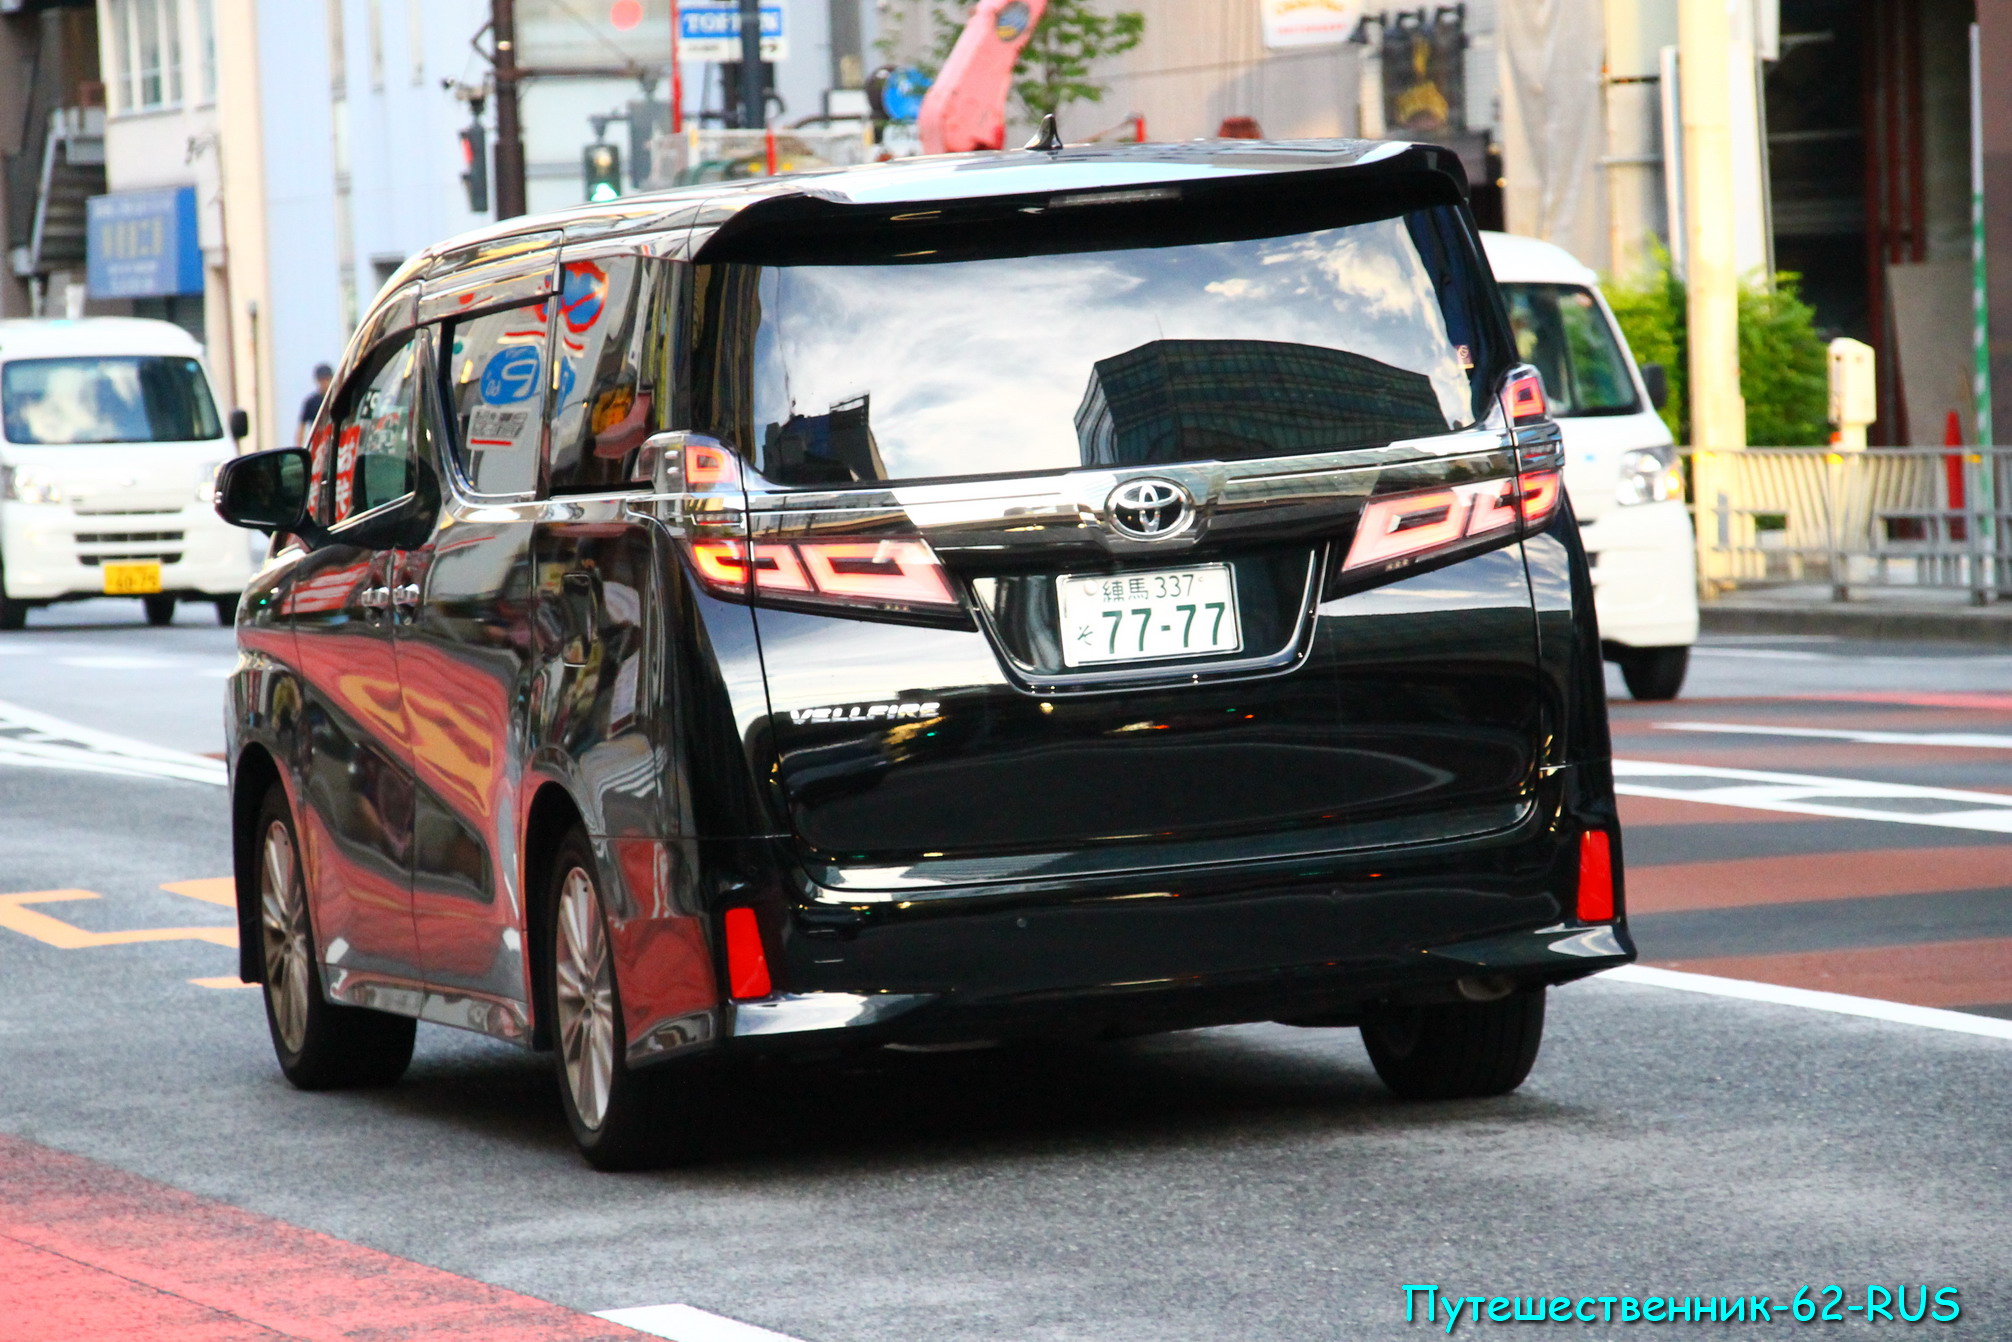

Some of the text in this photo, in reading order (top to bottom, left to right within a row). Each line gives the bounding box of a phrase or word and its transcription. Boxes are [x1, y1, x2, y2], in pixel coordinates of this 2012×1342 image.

[1102, 574, 1194, 603] 練馬 337
[1102, 602, 1226, 654] 77-77
[790, 702, 941, 725] VELLFIRE
